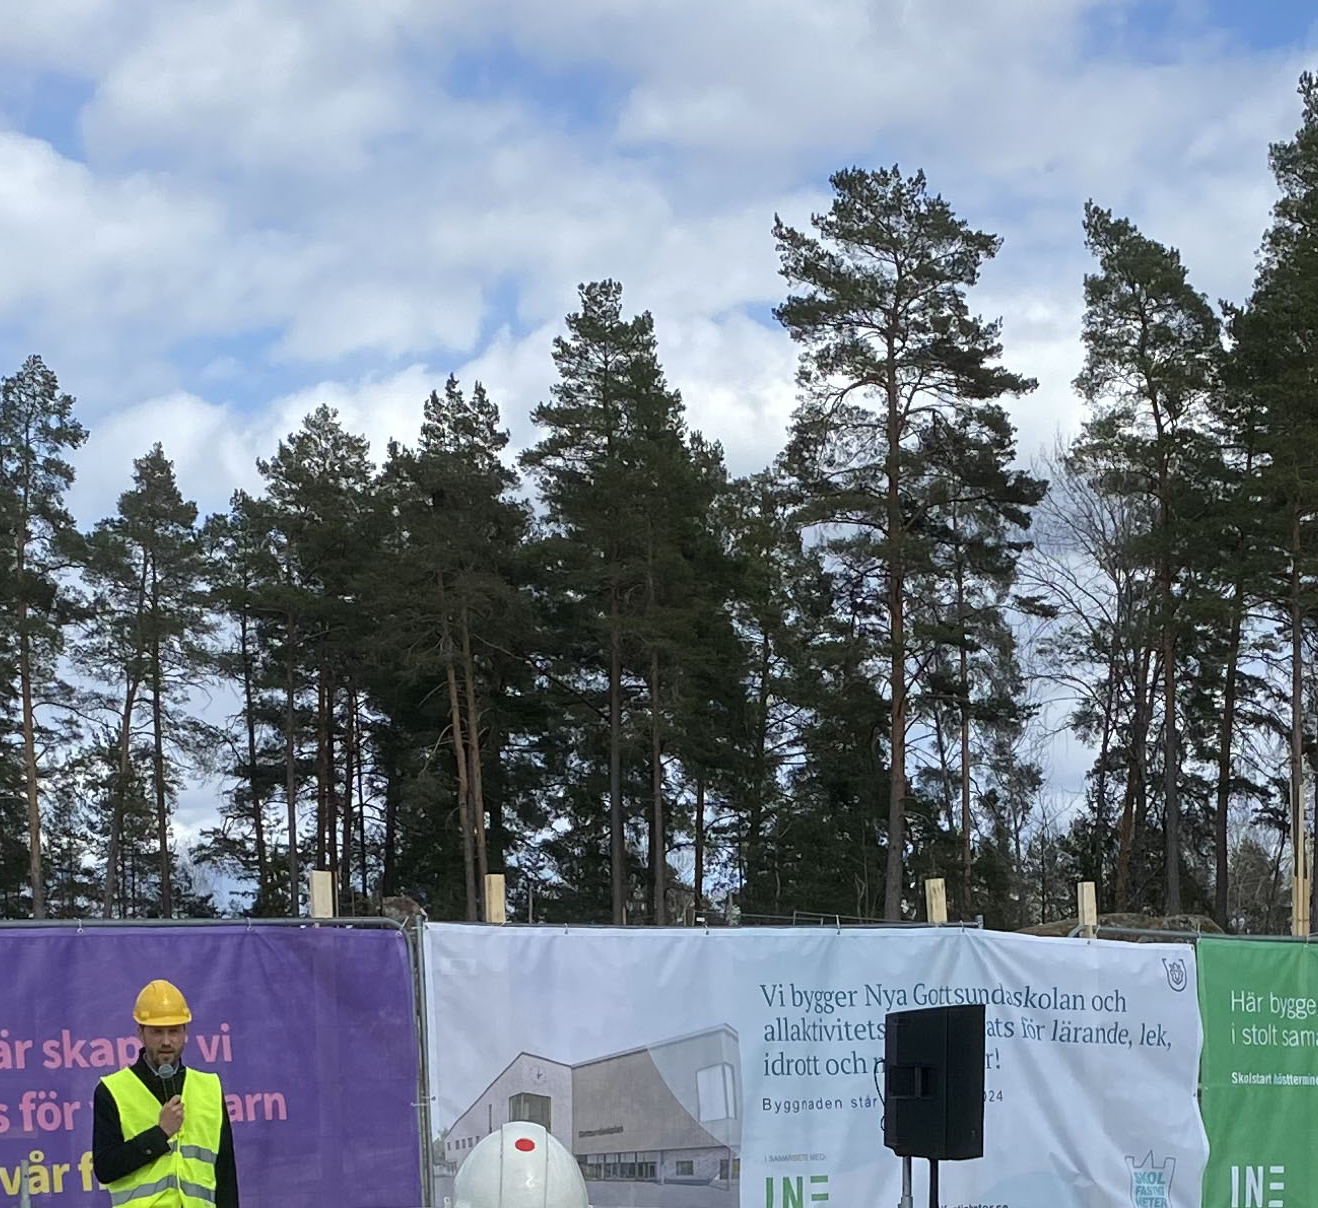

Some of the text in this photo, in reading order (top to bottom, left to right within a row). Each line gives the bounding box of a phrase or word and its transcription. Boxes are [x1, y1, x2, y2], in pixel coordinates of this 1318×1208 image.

[760, 983, 1127, 1014] Vi bygger Nya Gottsundaskolan och
[1231, 990, 1263, 1013] Här
[43, 1029, 188, 1068] skap
[196, 1022, 233, 1063] vi
[764, 1016, 1172, 1051] allaktivitets ats för lärande, lek,
[1231, 1022, 1236, 1045] i
[1242, 1023, 1278, 1046] stolt
[764, 1052, 821, 1076] idrott
[825, 1051, 868, 1076] och
[1231, 1072, 1272, 1085] Skolstart
[19, 1090, 81, 1132] för
[224, 1092, 288, 1122] arn
[762, 1090, 1003, 1114] Byggnaden står 24
[1133, 1171, 1166, 1185] SKOL
